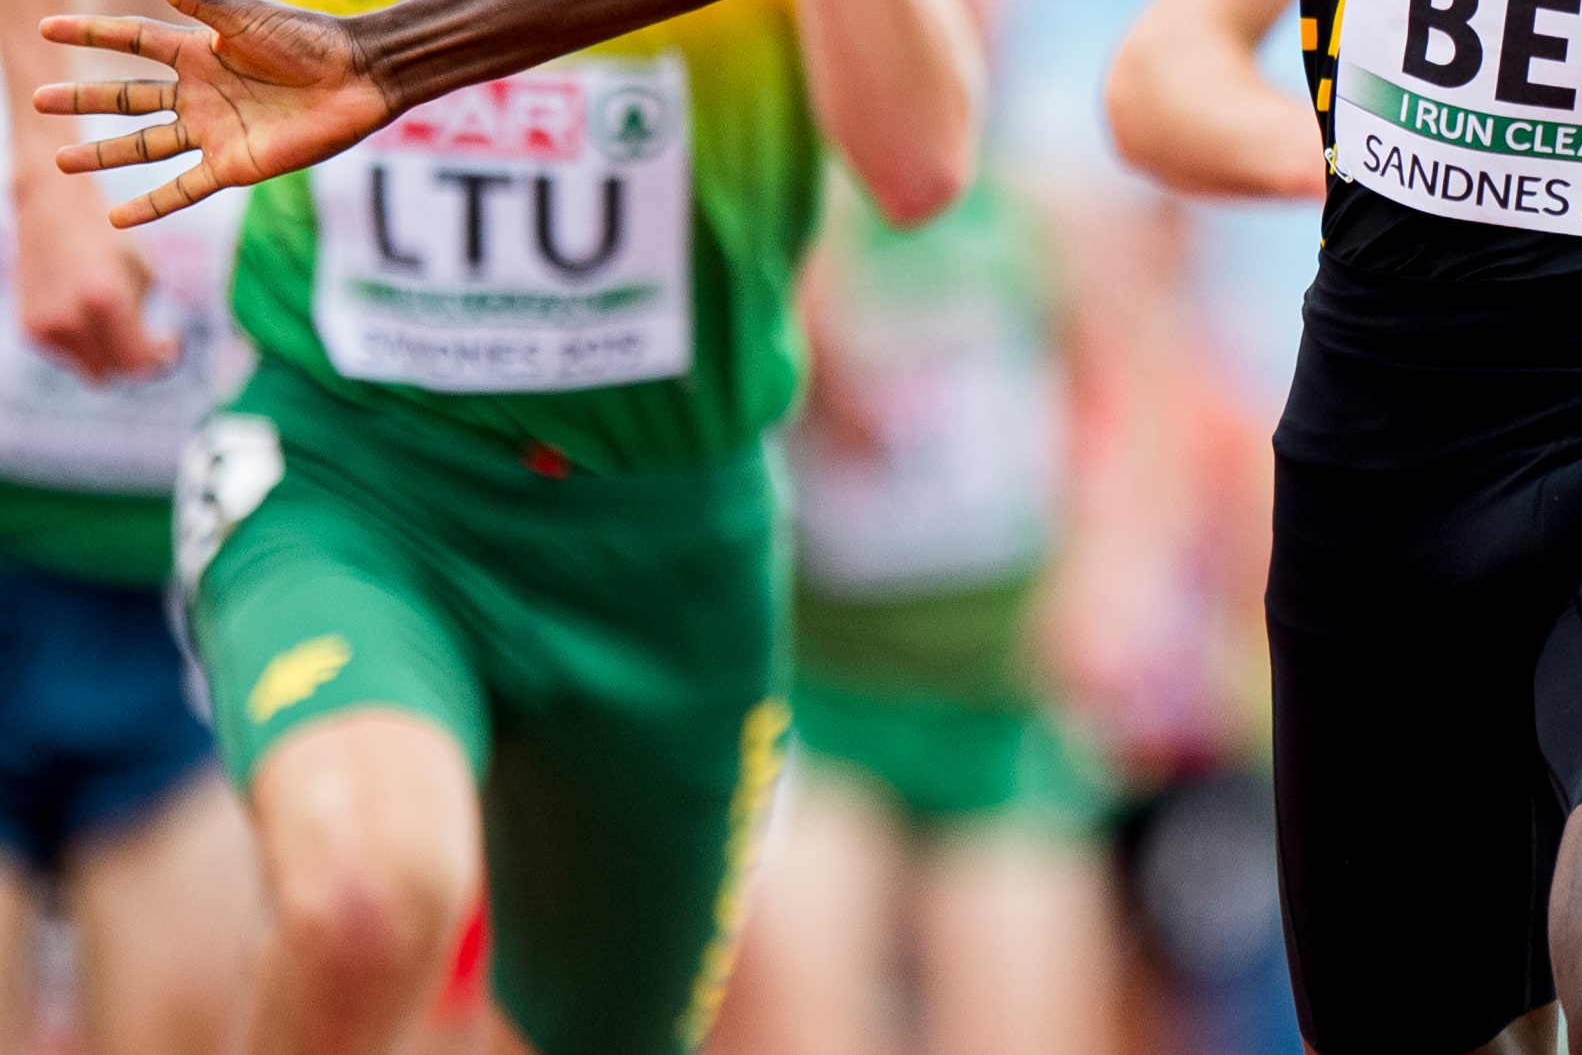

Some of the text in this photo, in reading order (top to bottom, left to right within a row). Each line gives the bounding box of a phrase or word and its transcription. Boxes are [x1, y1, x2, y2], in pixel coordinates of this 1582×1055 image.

[1400, 93, 1410, 123] I
[1415, 99, 1495, 147] RUN
[1363, 133, 1572, 217] SANDNES
[368, 162, 624, 279] LTU
